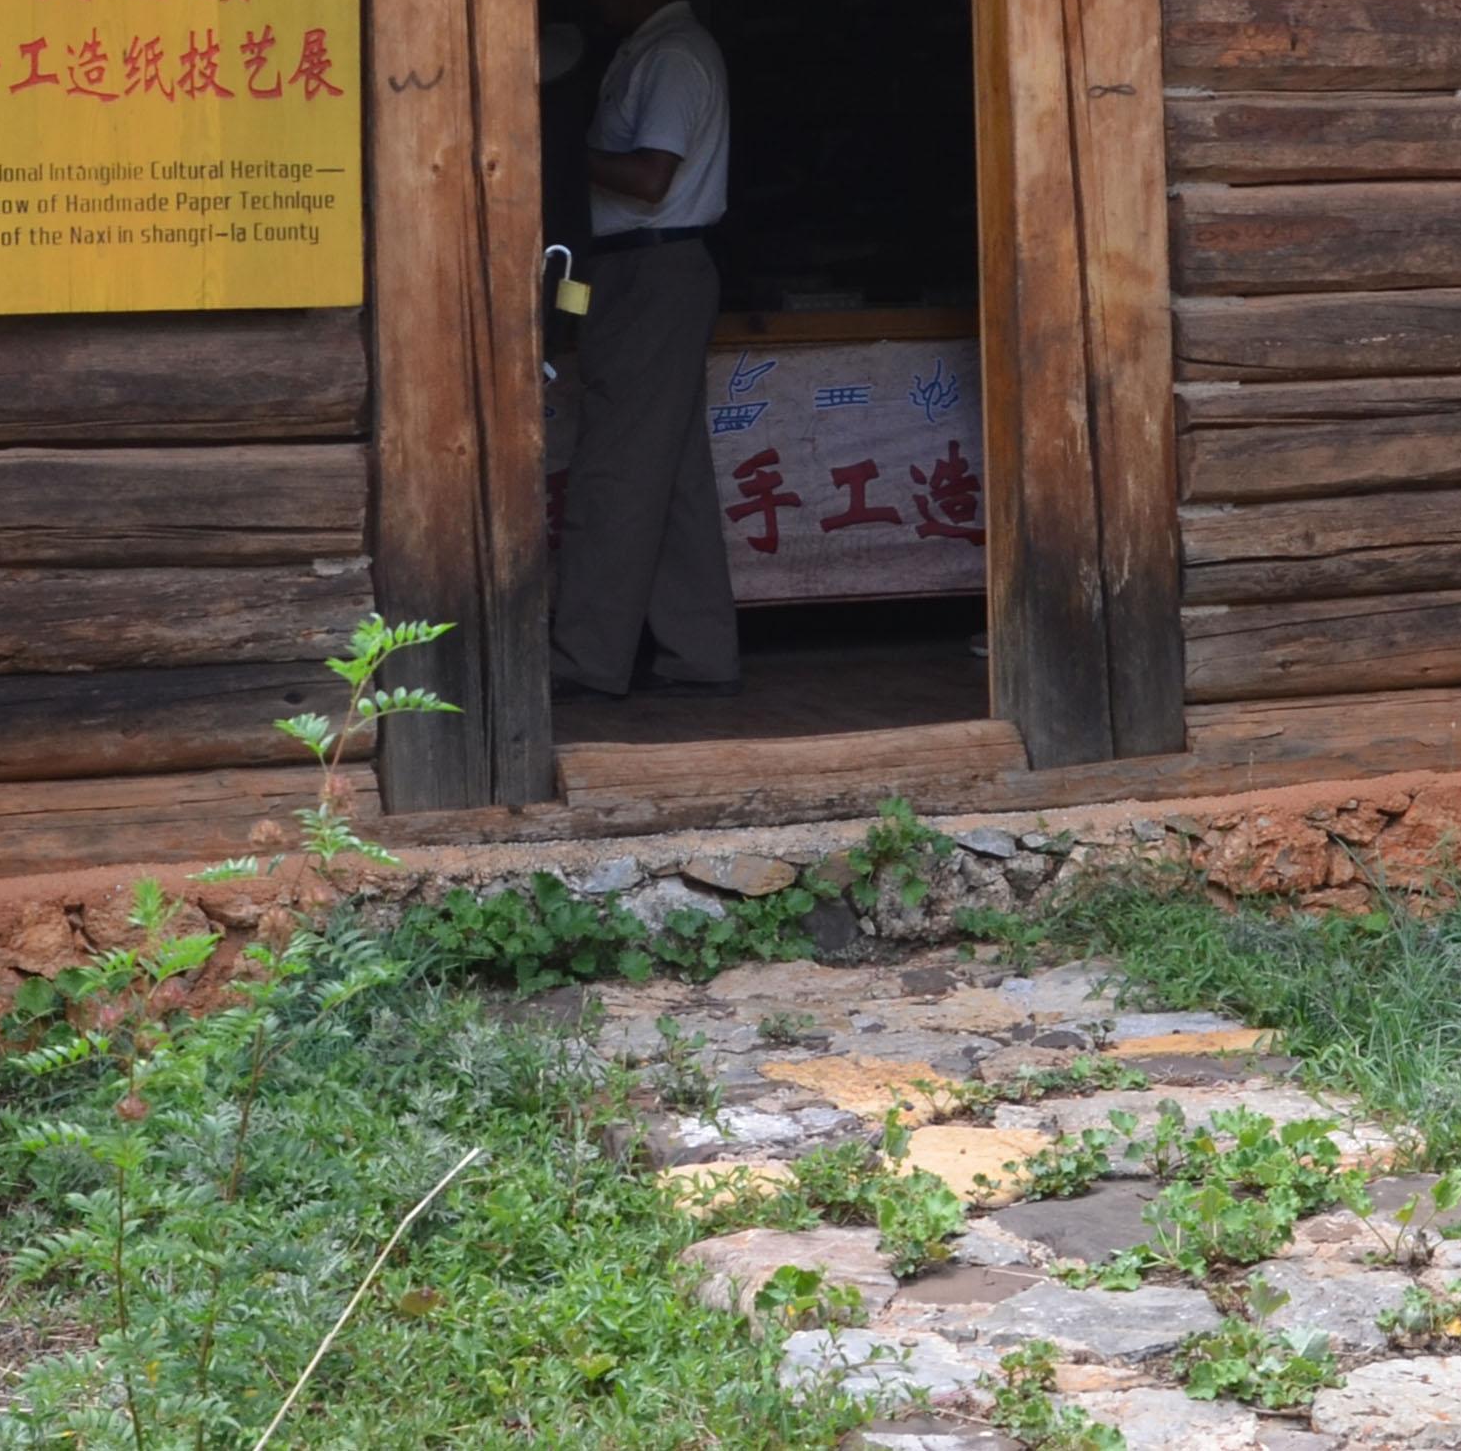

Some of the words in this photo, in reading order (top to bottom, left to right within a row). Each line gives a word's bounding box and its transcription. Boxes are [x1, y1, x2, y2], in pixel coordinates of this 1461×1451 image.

[150, 159, 225, 181] Cultural
[37, 194, 58, 214] of
[66, 193, 169, 214] Handmade
[176, 192, 232, 216] Paper
[239, 190, 336, 214] Technique
[0, 227, 22, 247] of
[29, 227, 63, 246] the
[69, 226, 112, 245] Naxi
[117, 226, 134, 244] in
[253, 222, 320, 246] County
[724, 440, 987, 555] 手工造
